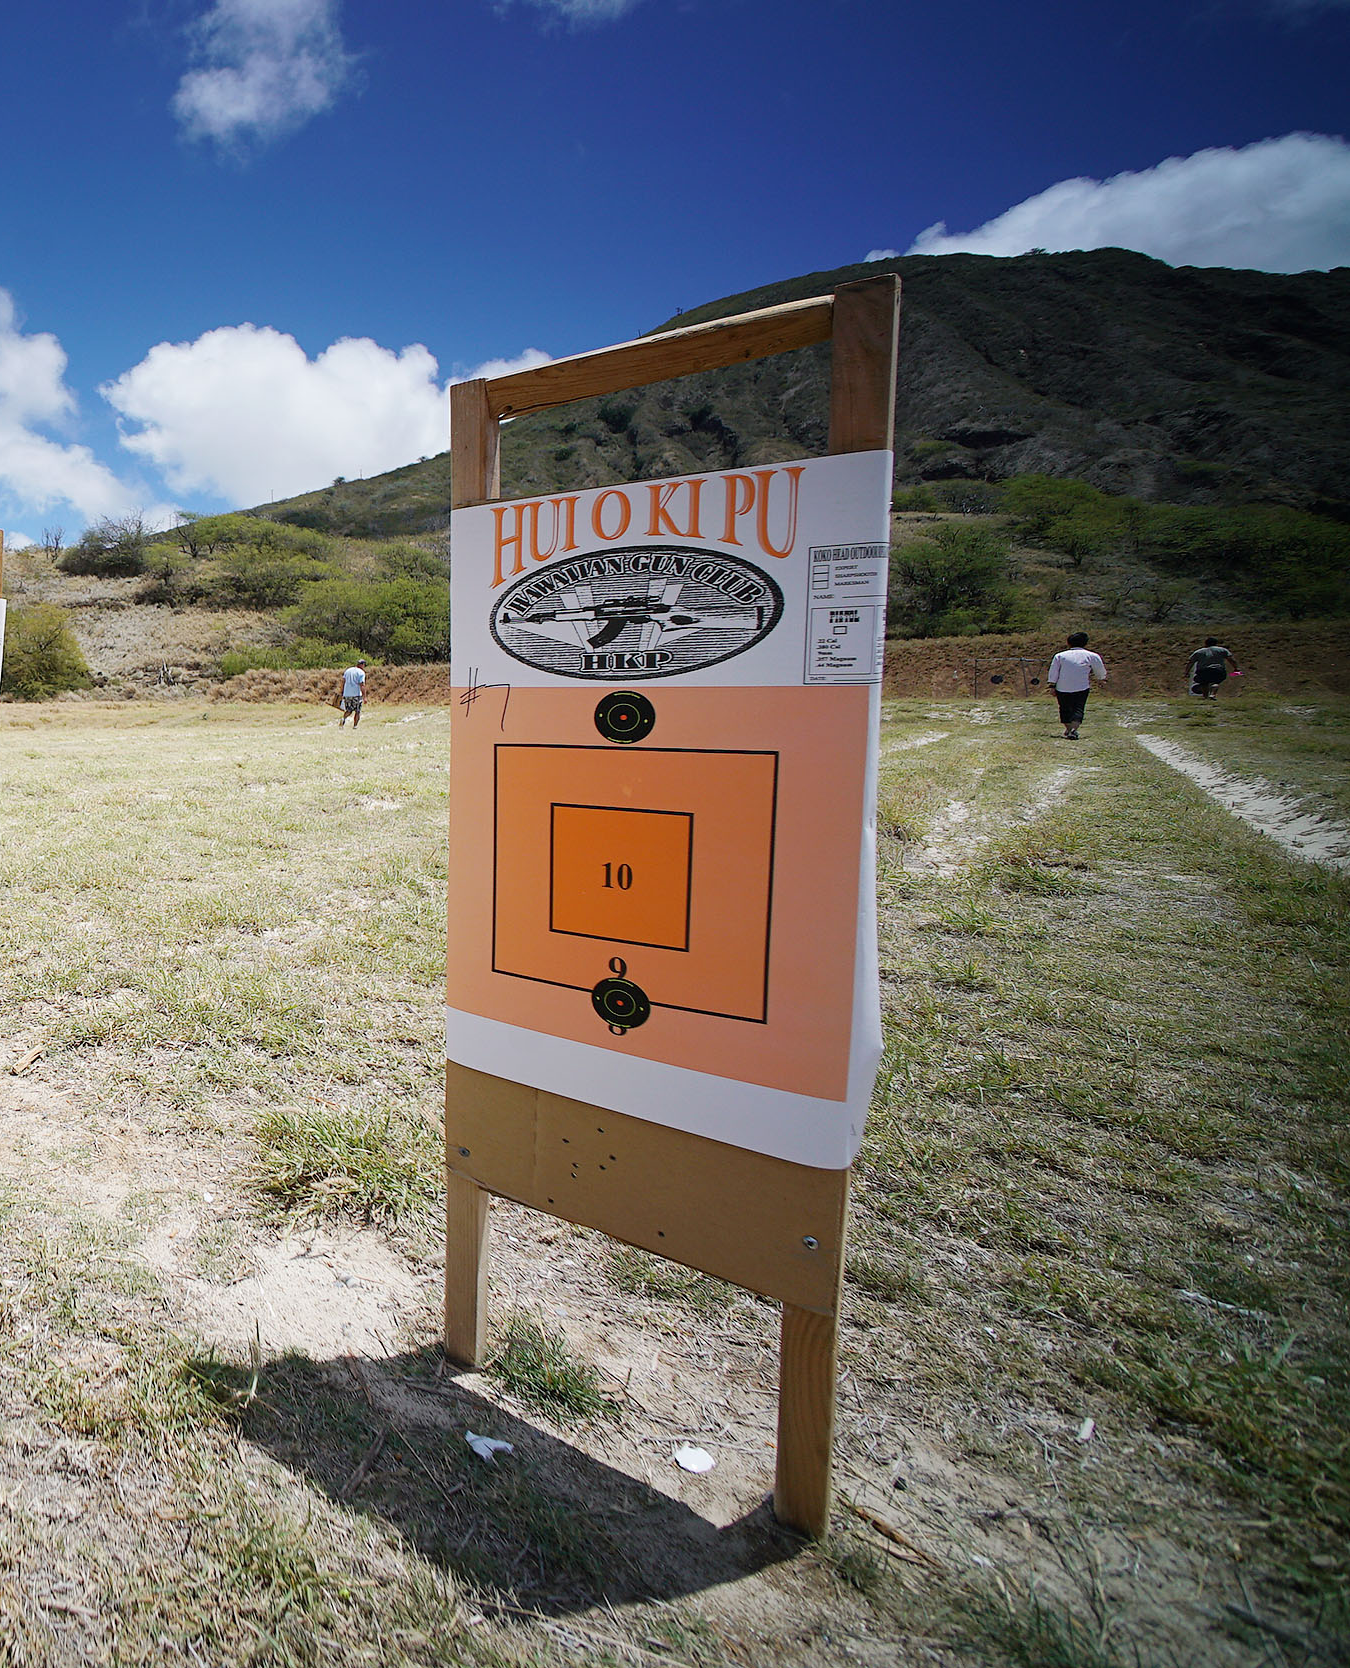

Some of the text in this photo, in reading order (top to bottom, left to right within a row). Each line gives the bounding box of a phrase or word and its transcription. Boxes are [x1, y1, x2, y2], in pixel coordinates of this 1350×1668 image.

[489, 467, 806, 589] HUI O KI PU
[813, 550, 831, 562] KOKO
[833, 548, 849, 560] HEAD
[505, 553, 766, 617] HAWAIIAN GUN CLUB
[579, 650, 674, 674] HKP
[459, 667, 510, 732] #7
[600, 861, 634, 891] 10
